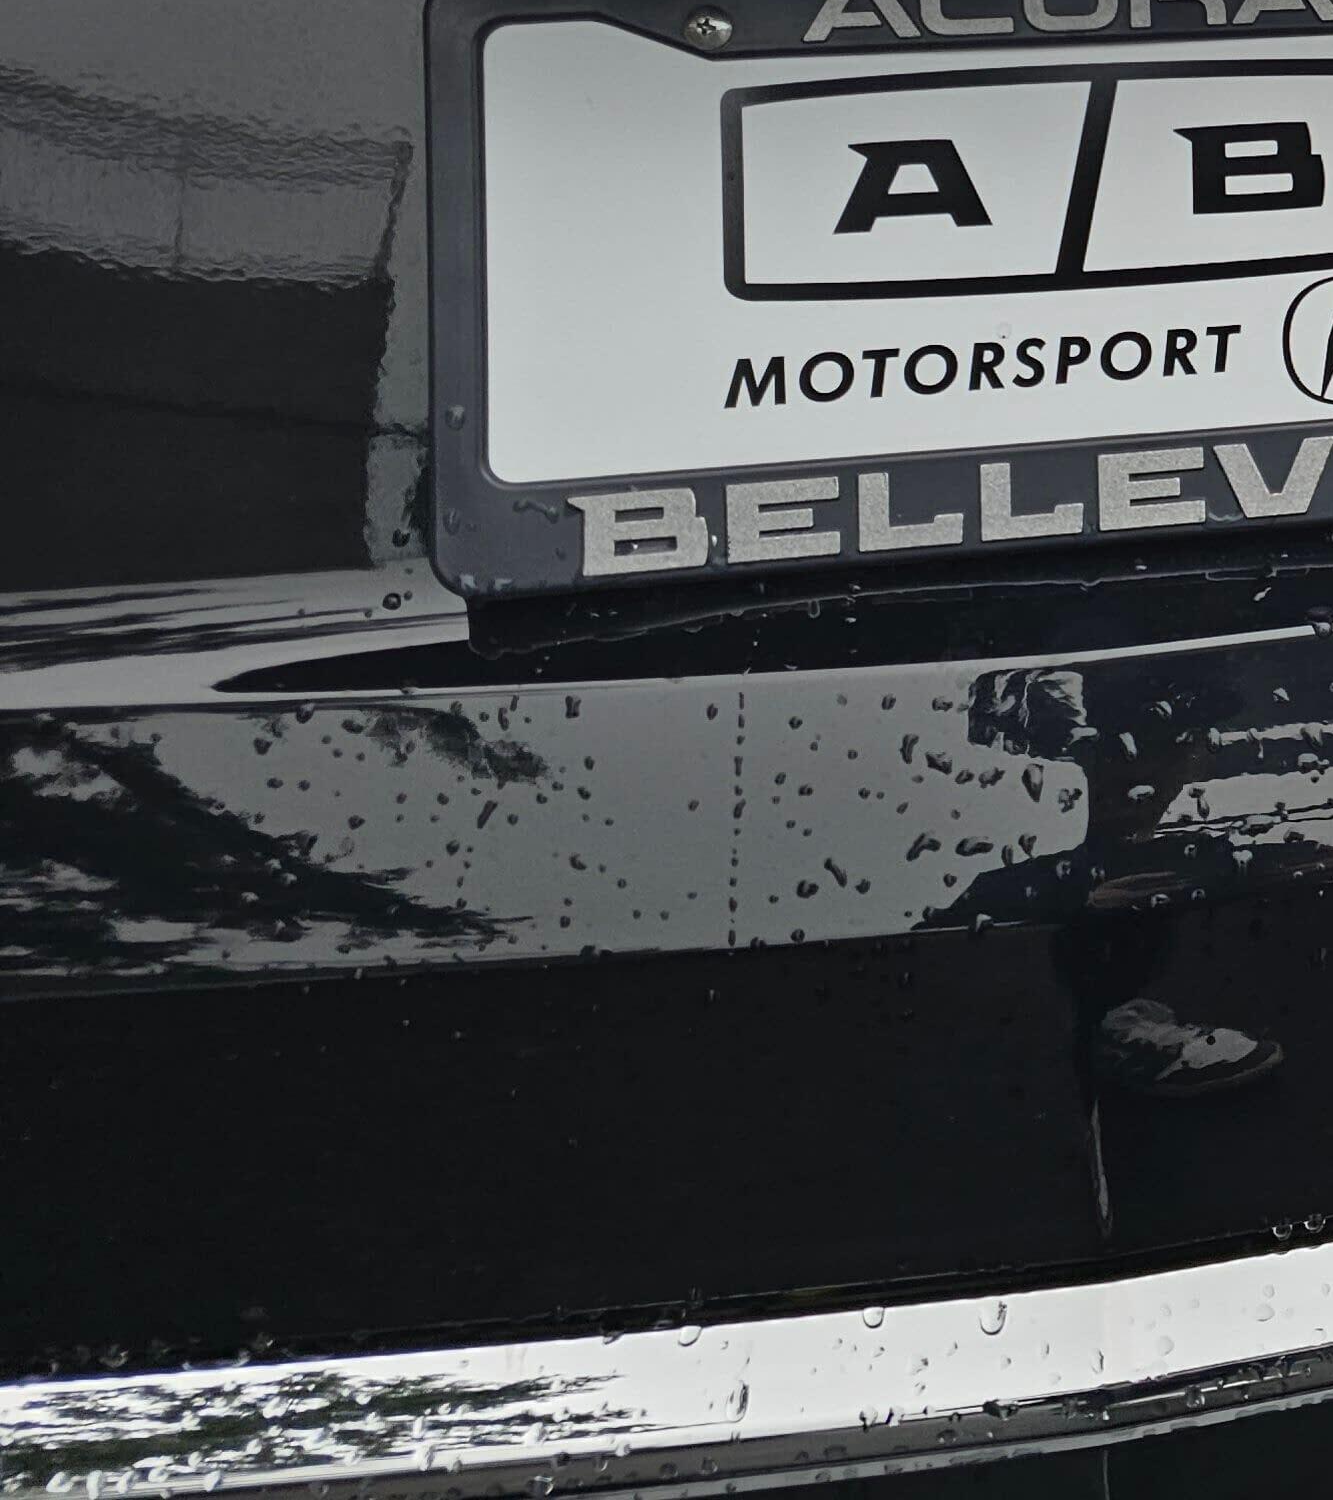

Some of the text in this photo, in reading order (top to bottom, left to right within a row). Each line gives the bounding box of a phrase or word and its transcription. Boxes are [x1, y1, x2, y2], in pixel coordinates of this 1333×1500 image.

[833, 121, 1326, 234] A B
[724, 324, 1241, 408] MOTORSPORT
